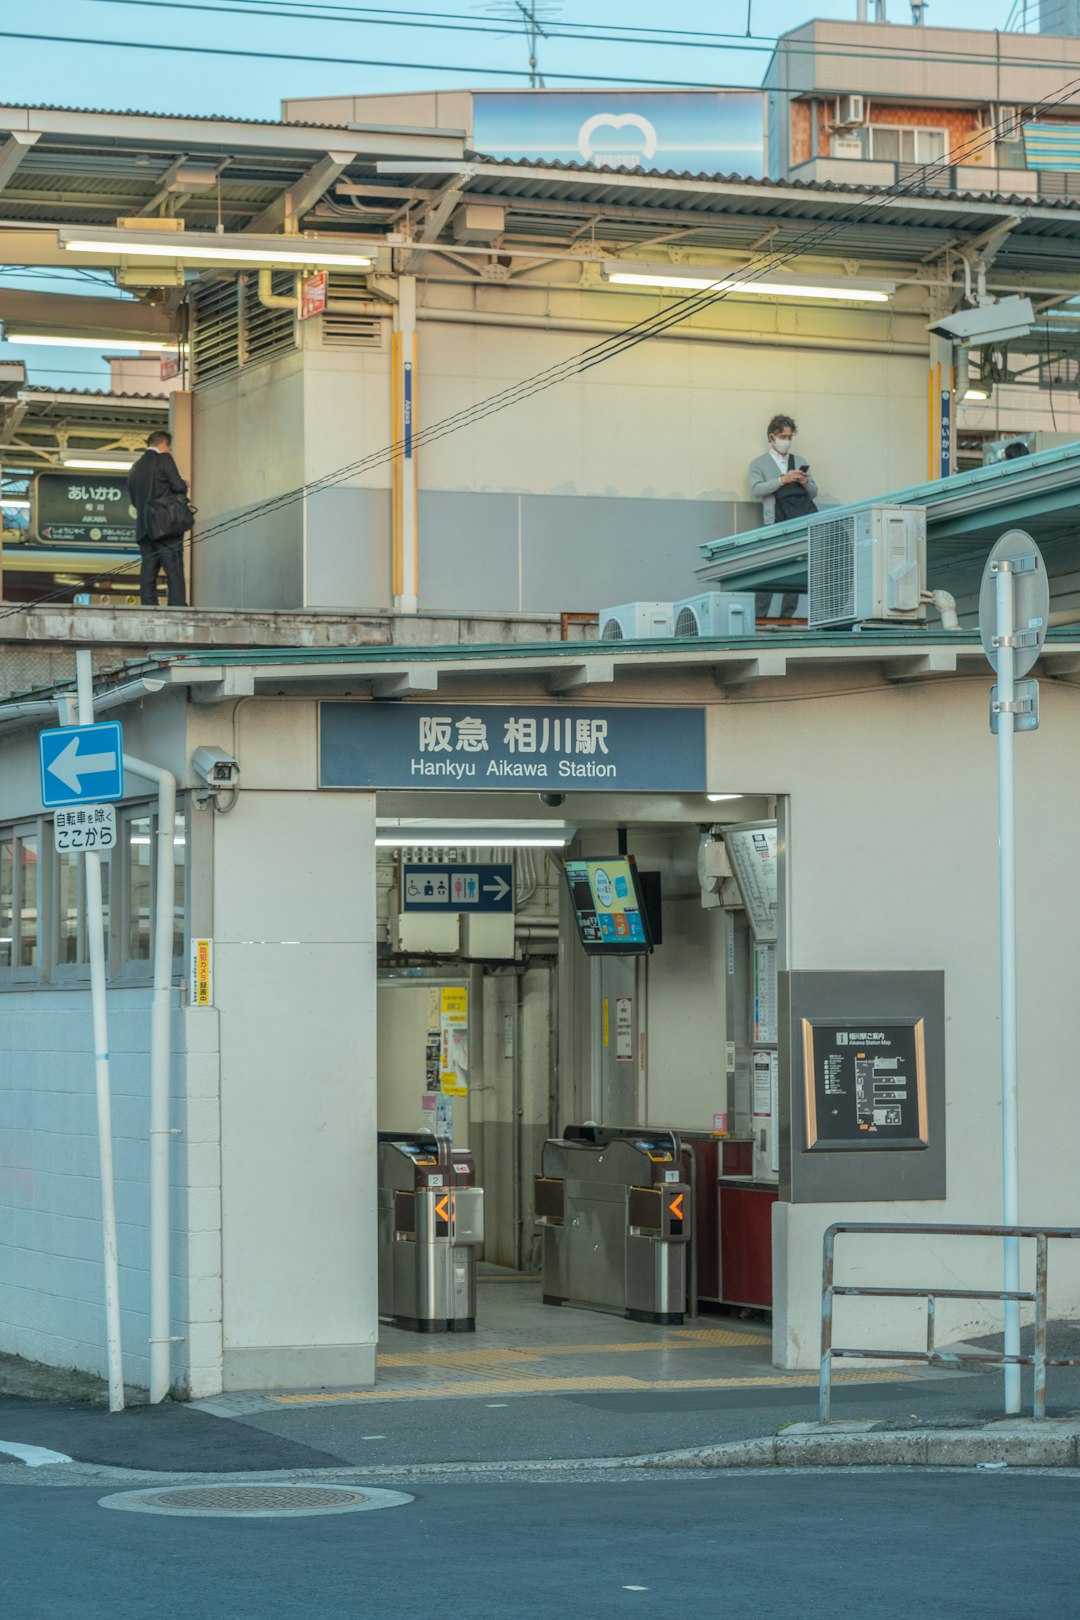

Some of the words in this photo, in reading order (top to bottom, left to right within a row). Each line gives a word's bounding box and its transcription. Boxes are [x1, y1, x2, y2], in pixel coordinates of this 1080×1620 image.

[68, 486, 121, 501] あいかわ
[419, 716, 489, 752] 阪急
[503, 717, 609, 754] 相川駅
[411, 759, 476, 779] Hankyu
[486, 760, 548, 777] Aikawa
[558, 760, 617, 777] Station
[56, 808, 112, 827] 自転車を除く
[58, 827, 112, 848] ここから
